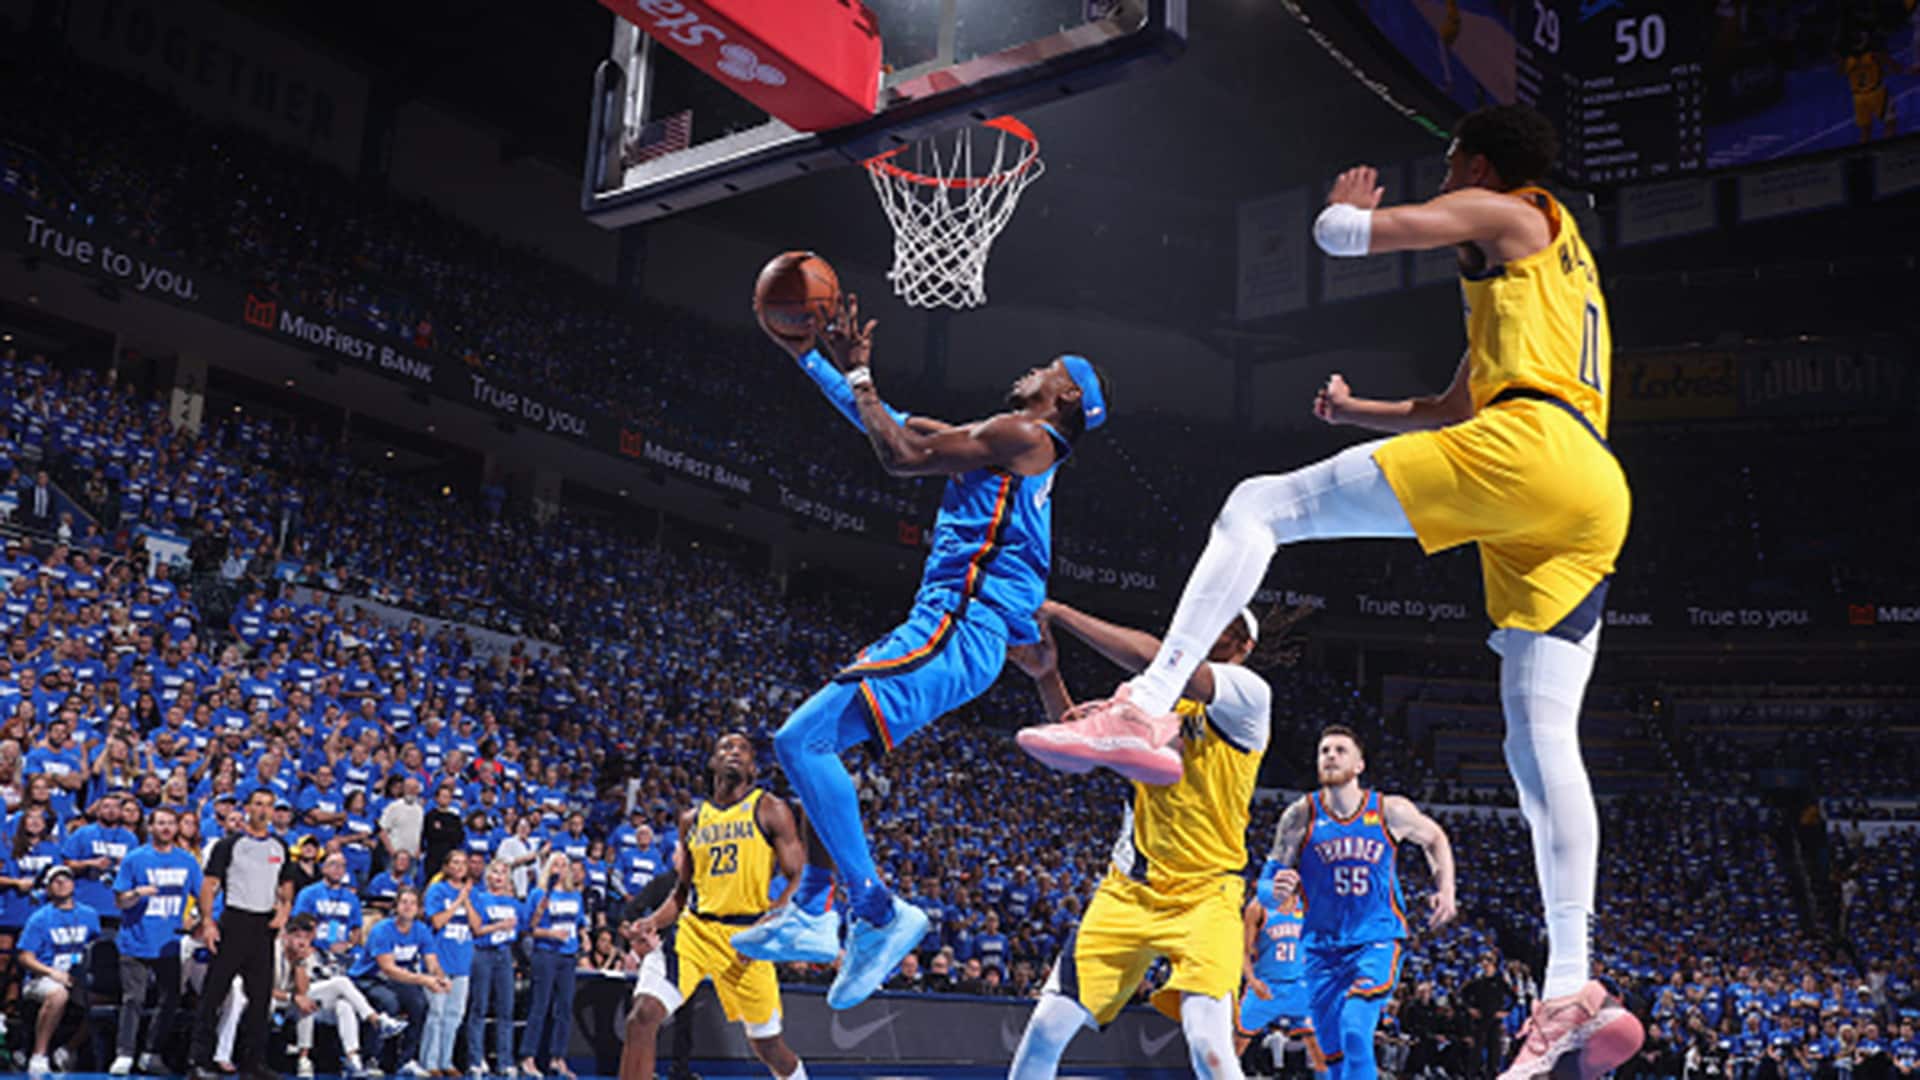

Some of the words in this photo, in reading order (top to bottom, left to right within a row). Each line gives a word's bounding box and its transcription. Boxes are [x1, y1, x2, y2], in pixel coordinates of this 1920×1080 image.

[1615, 12, 1667, 65] 50
[24, 213, 95, 264] True
[100, 245, 133, 277] to
[1579, 299, 1602, 393] 0
[471, 373, 518, 413] True
[522, 396, 544, 421] to
[778, 483, 813, 516] True
[815, 501, 832, 523] to
[1056, 555, 1095, 584] True
[1098, 567, 1117, 585] to
[1355, 593, 1401, 616] True
[1404, 600, 1425, 616] to
[1687, 606, 1737, 625] True
[1740, 607, 1763, 625] to
[710, 843, 739, 877] 23
[1314, 836, 1385, 864] THUNDER
[1333, 865, 1369, 896] 55
